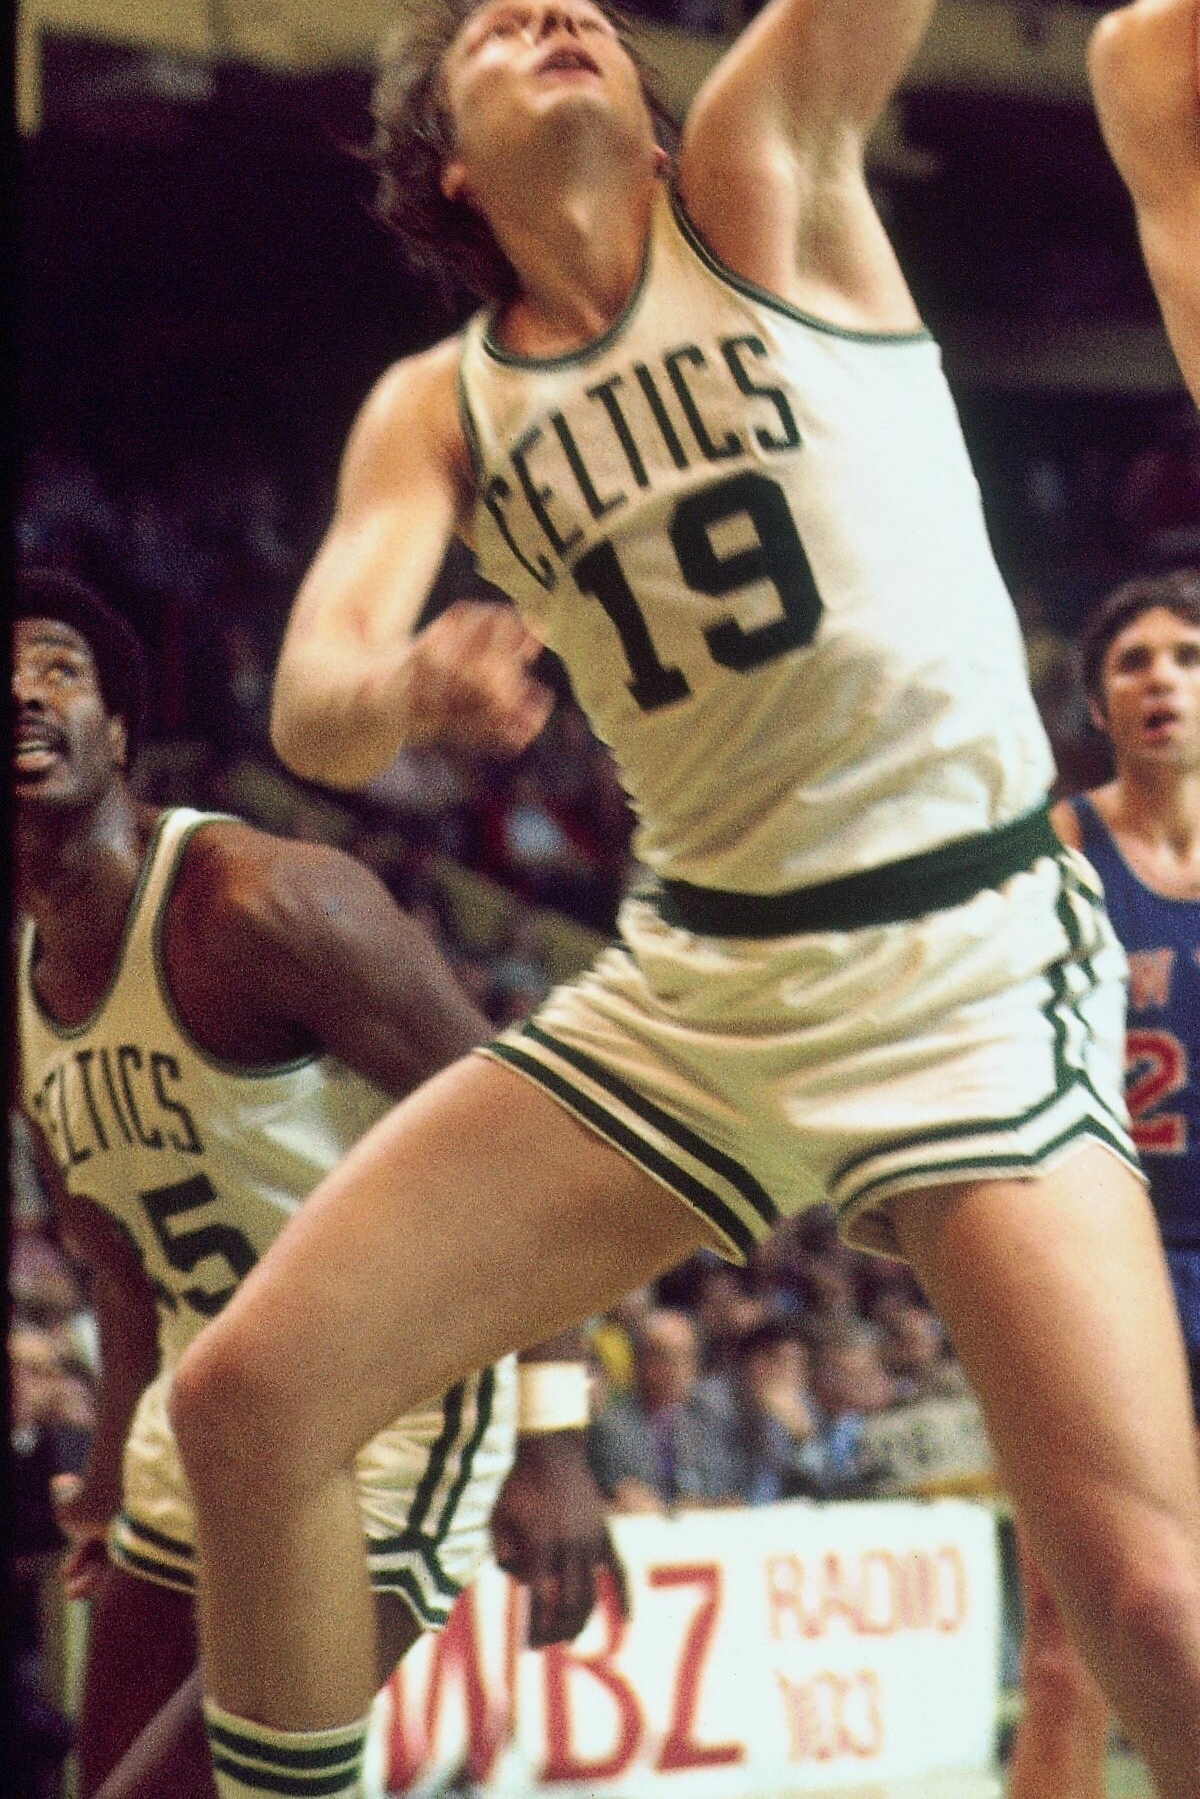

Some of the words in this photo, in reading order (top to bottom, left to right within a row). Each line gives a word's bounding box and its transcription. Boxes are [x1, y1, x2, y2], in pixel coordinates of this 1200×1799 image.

[484, 334, 804, 593] CELTICS
[571, 469, 826, 712] 19
[383, 1562, 746, 1793] WBZ
[764, 1543, 968, 1641] RADIO
